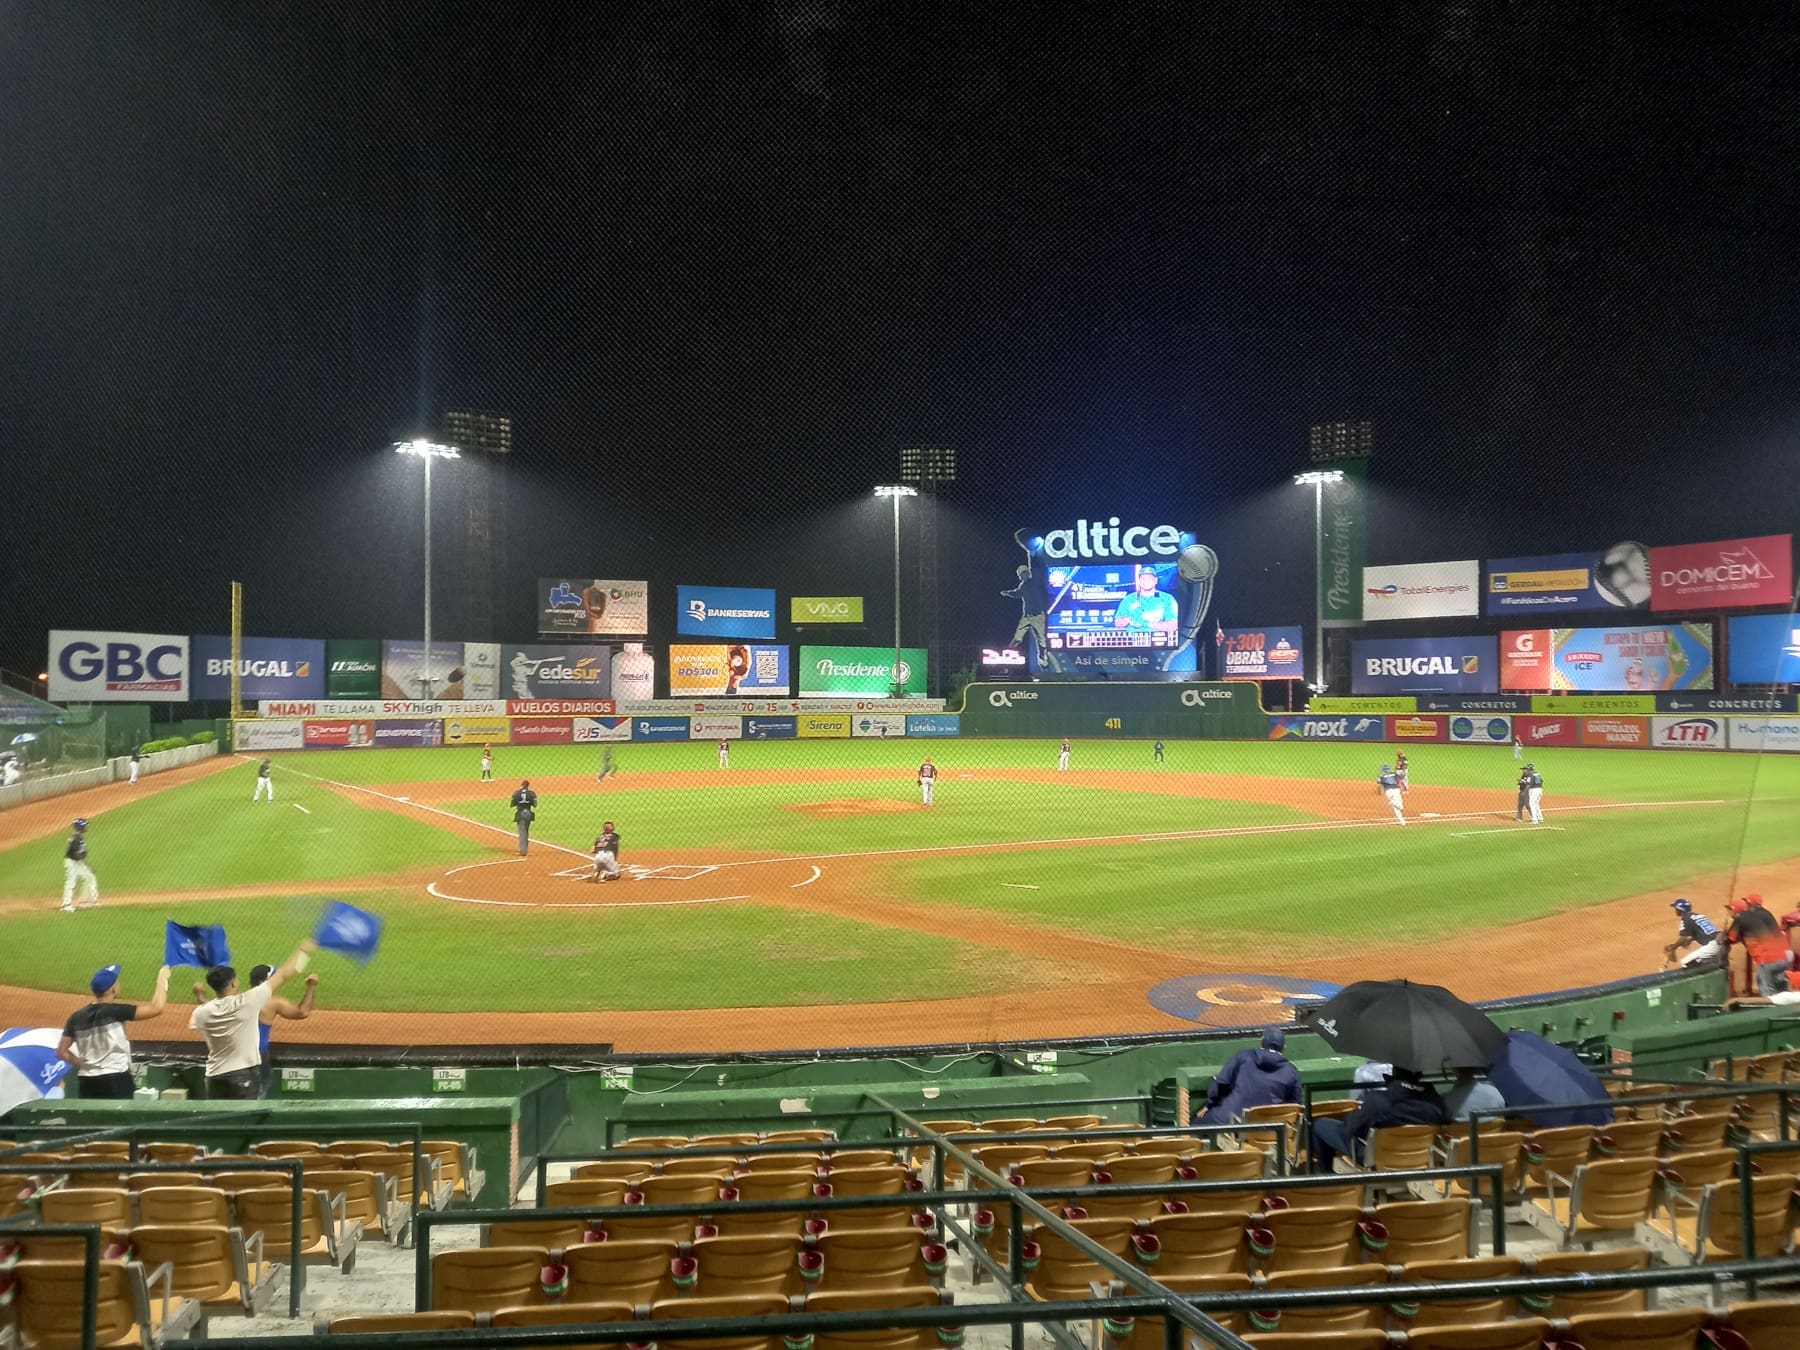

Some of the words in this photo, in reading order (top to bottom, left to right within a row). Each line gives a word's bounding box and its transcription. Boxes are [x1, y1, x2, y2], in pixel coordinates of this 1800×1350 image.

[1043, 517, 1180, 558] altice
[1661, 563, 1761, 587] DOMICEM
[1400, 584, 1470, 595] TotalEnergies
[708, 609, 770, 618] BANRESERVAS
[58, 641, 182, 682] GBC
[1094, 655, 1109, 665] de
[1111, 655, 1149, 668] simple
[1226, 651, 1265, 665] OBRAS
[207, 659, 293, 677] BRUGAL
[539, 664, 601, 680] edesur
[816, 659, 889, 677] Presidente
[1366, 656, 1460, 676] BRUGAL
[1575, 663, 1593, 671] ICE
[1010, 691, 1038, 700] altice
[1202, 689, 1232, 699] altice
[268, 703, 316, 715] MIAMI
[323, 704, 336, 714] TE
[338, 704, 375, 714] LLAMA
[383, 702, 442, 714] SKYhigh
[448, 704, 461, 712] TE
[464, 704, 495, 713] LLEVA
[512, 702, 560, 713] VUELOS
[562, 702, 611, 713] DIARIOS
[1461, 701, 1518, 709] CONCRETOS
[1583, 700, 1640, 709] CEMENTOS
[1709, 700, 1782, 709] CONCRETOS
[807, 720, 842, 731] Sirena
[1105, 717, 1121, 729] 411
[1303, 718, 1348, 737] next
[1738, 723, 1799, 734] Humano
[1666, 725, 1709, 741] LTH
